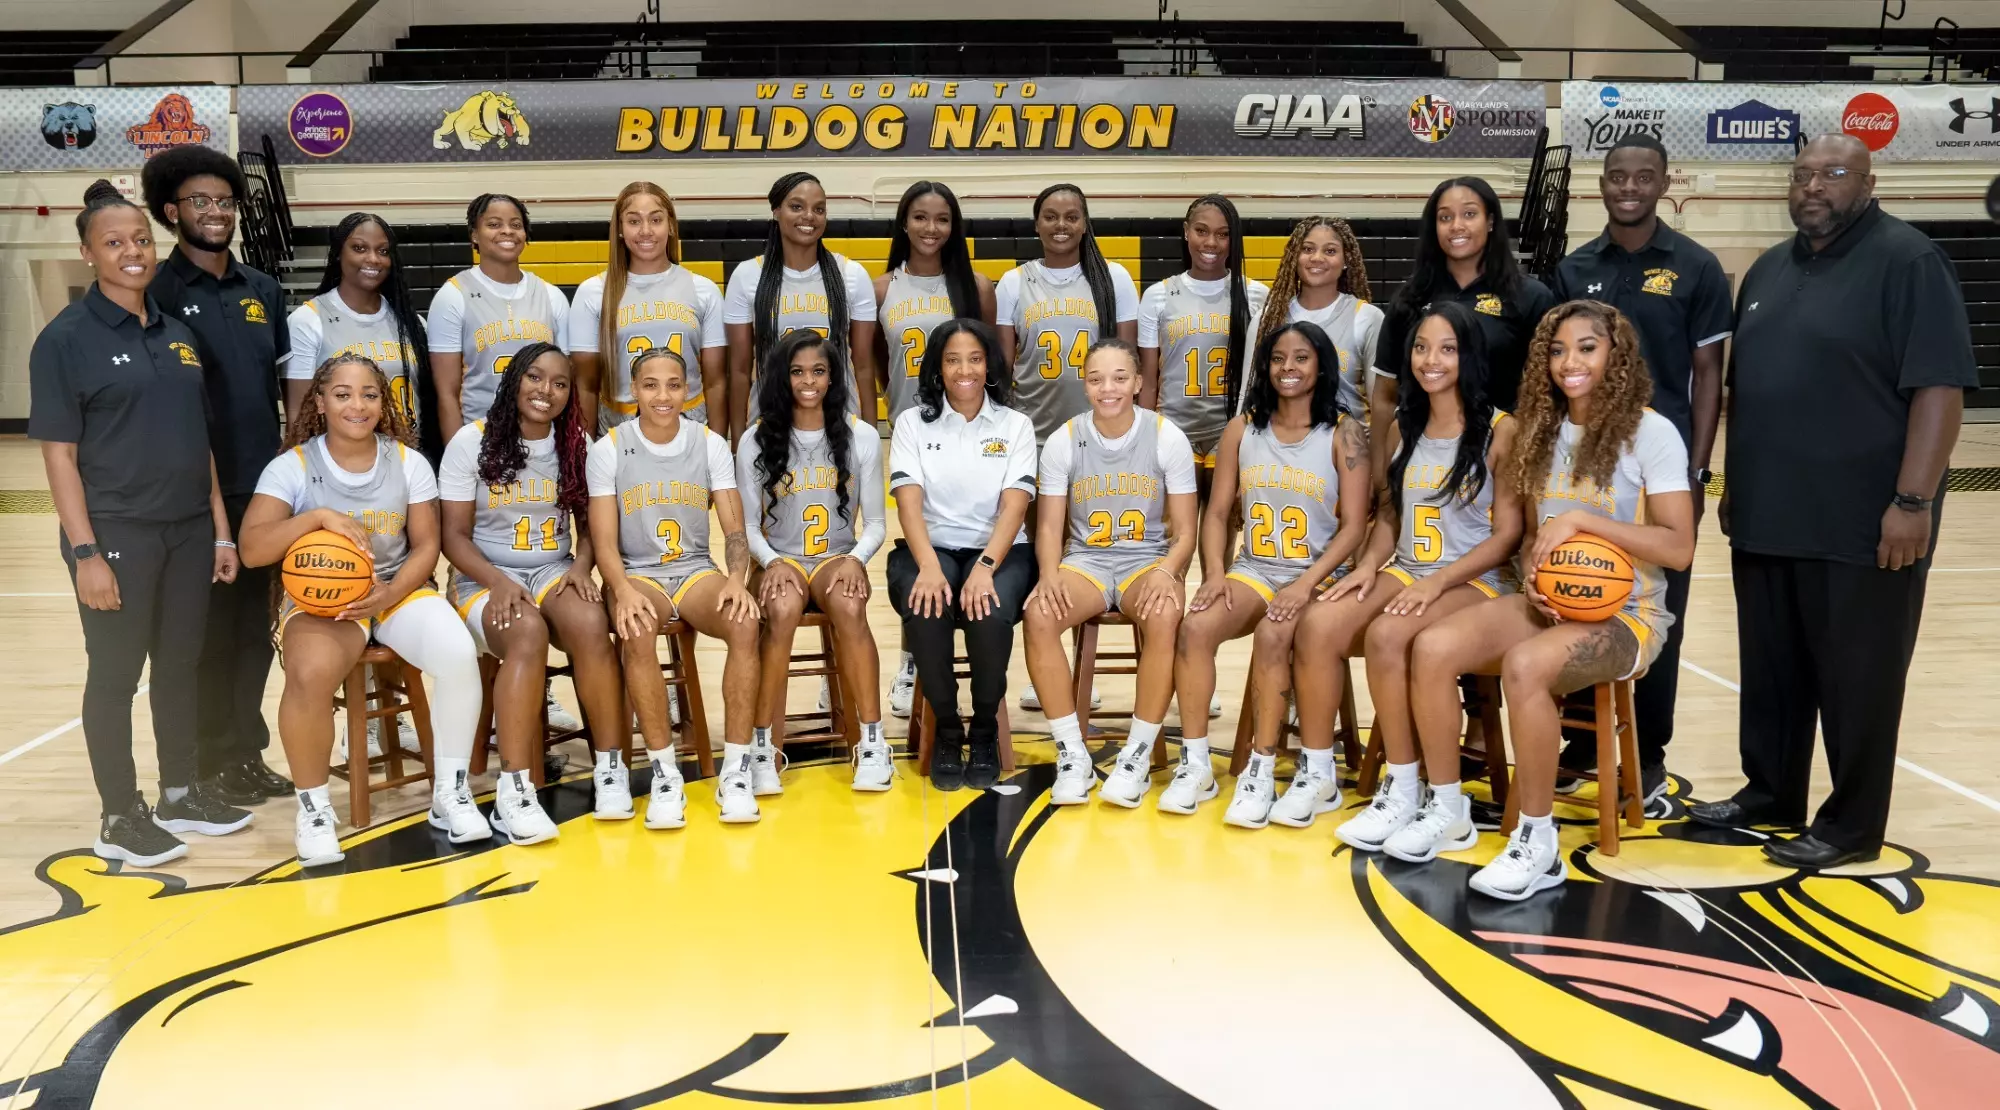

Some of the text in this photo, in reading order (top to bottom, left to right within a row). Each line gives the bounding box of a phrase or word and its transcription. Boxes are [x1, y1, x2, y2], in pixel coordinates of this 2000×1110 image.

[755, 83, 1037, 99] WELCOME TO
[296, 106, 343, 124] Experience
[615, 103, 1178, 153] BULLDOG NATION
[1233, 93, 1366, 139] CIAA
[1456, 109, 1537, 127] SPORTS
[1614, 109, 1666, 120] MAKE IT
[1716, 116, 1791, 139] LOWE'S
[1844, 111, 1896, 130] Coca-Cola
[133, 130, 204, 145] LINCOLN
[1481, 126, 1537, 136] COMMISSION
[1936, 140, 1970, 148] UNDER
[616, 300, 697, 329] ULLDOGS
[1036, 328, 1091, 381] 34
[1183, 346, 1230, 398] 12
[622, 480, 708, 517] BULLDOGS
[1072, 472, 1158, 505] BULLDOGS
[509, 514, 560, 552] 11
[656, 518, 684, 566] 3
[801, 503, 830, 558] 2
[1086, 509, 1147, 548] 23
[1249, 501, 1312, 560] 22
[1412, 503, 1444, 563] 5
[294, 552, 357, 573] Wilson
[1549, 550, 1616, 573] Wilson
[1553, 580, 1603, 599] NCAA
